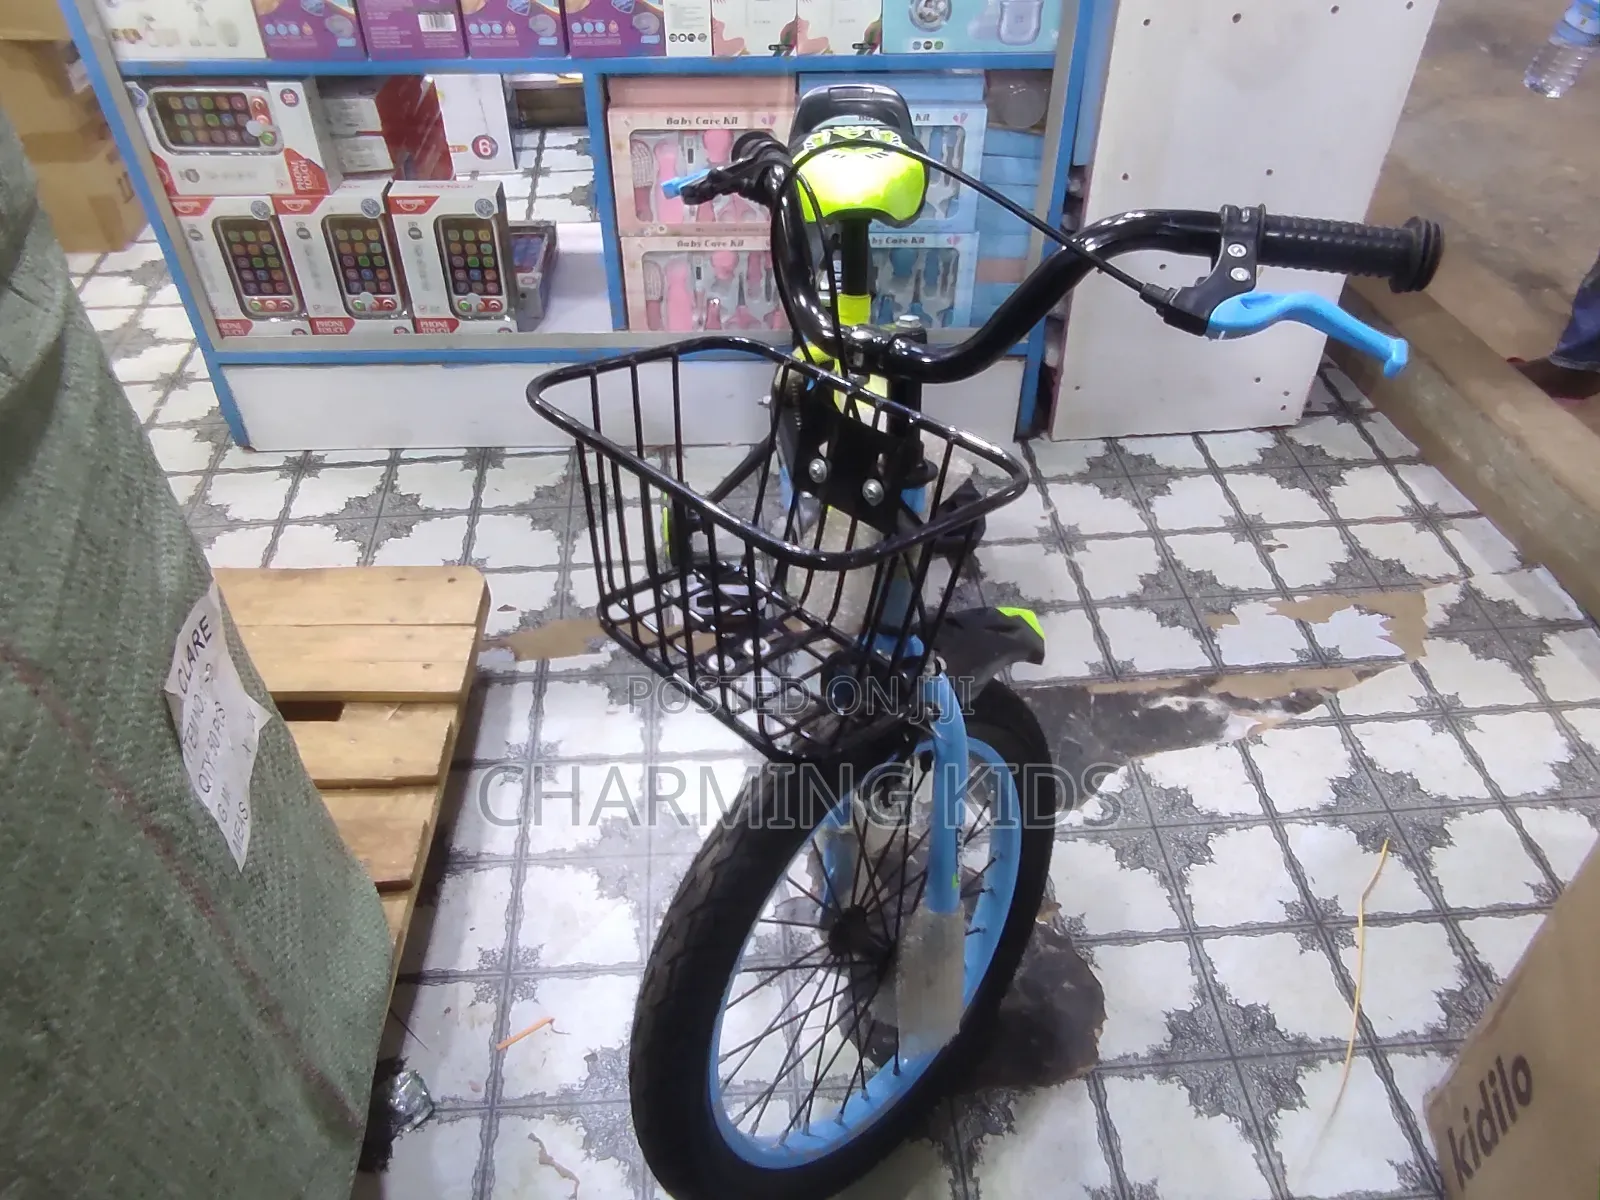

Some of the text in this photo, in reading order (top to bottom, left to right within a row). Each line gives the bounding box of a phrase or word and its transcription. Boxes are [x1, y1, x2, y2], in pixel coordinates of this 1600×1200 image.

[666, 116, 739, 126] Baby Care Kit
[479, 138, 492, 156] 6
[290, 160, 306, 190] PHONE
[298, 160, 313, 189] TOUCH
[677, 240, 702, 248] Baby
[704, 240, 727, 248] Care
[885, 236, 908, 244] Care
[315, 320, 344, 328] PHONE
[420, 320, 449, 328] PHONE
[178, 615, 212, 694] CLARE
[1447, 1054, 1533, 1192] kidilo
